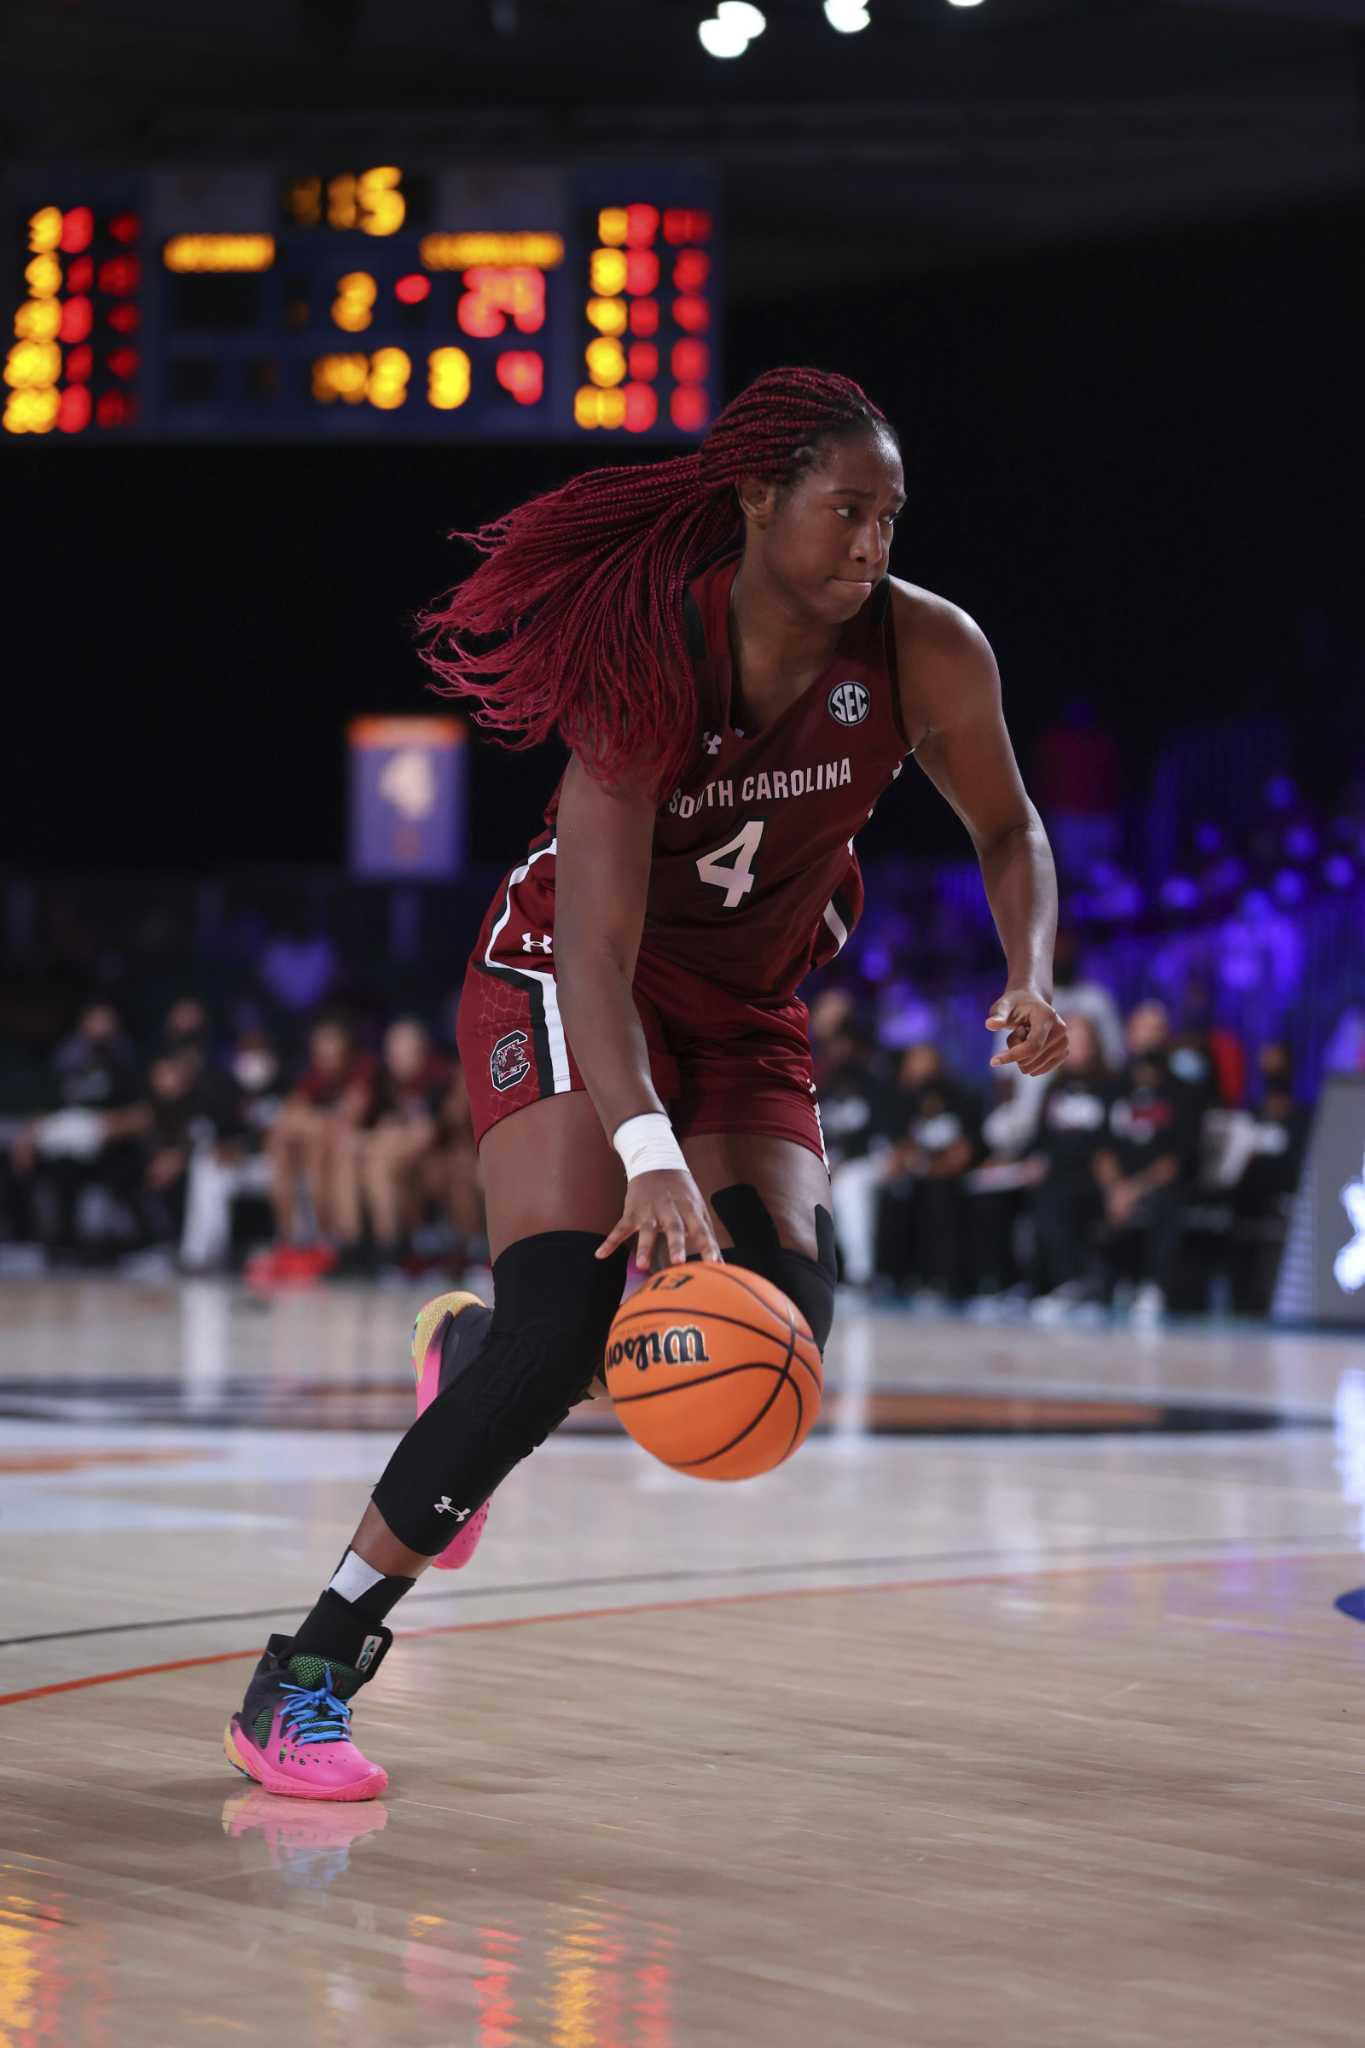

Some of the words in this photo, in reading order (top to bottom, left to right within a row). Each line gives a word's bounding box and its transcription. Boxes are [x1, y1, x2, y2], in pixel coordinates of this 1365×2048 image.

[831, 683, 869, 723] SEC
[742, 758, 852, 801] CAROLINA
[696, 821, 764, 907] 4
